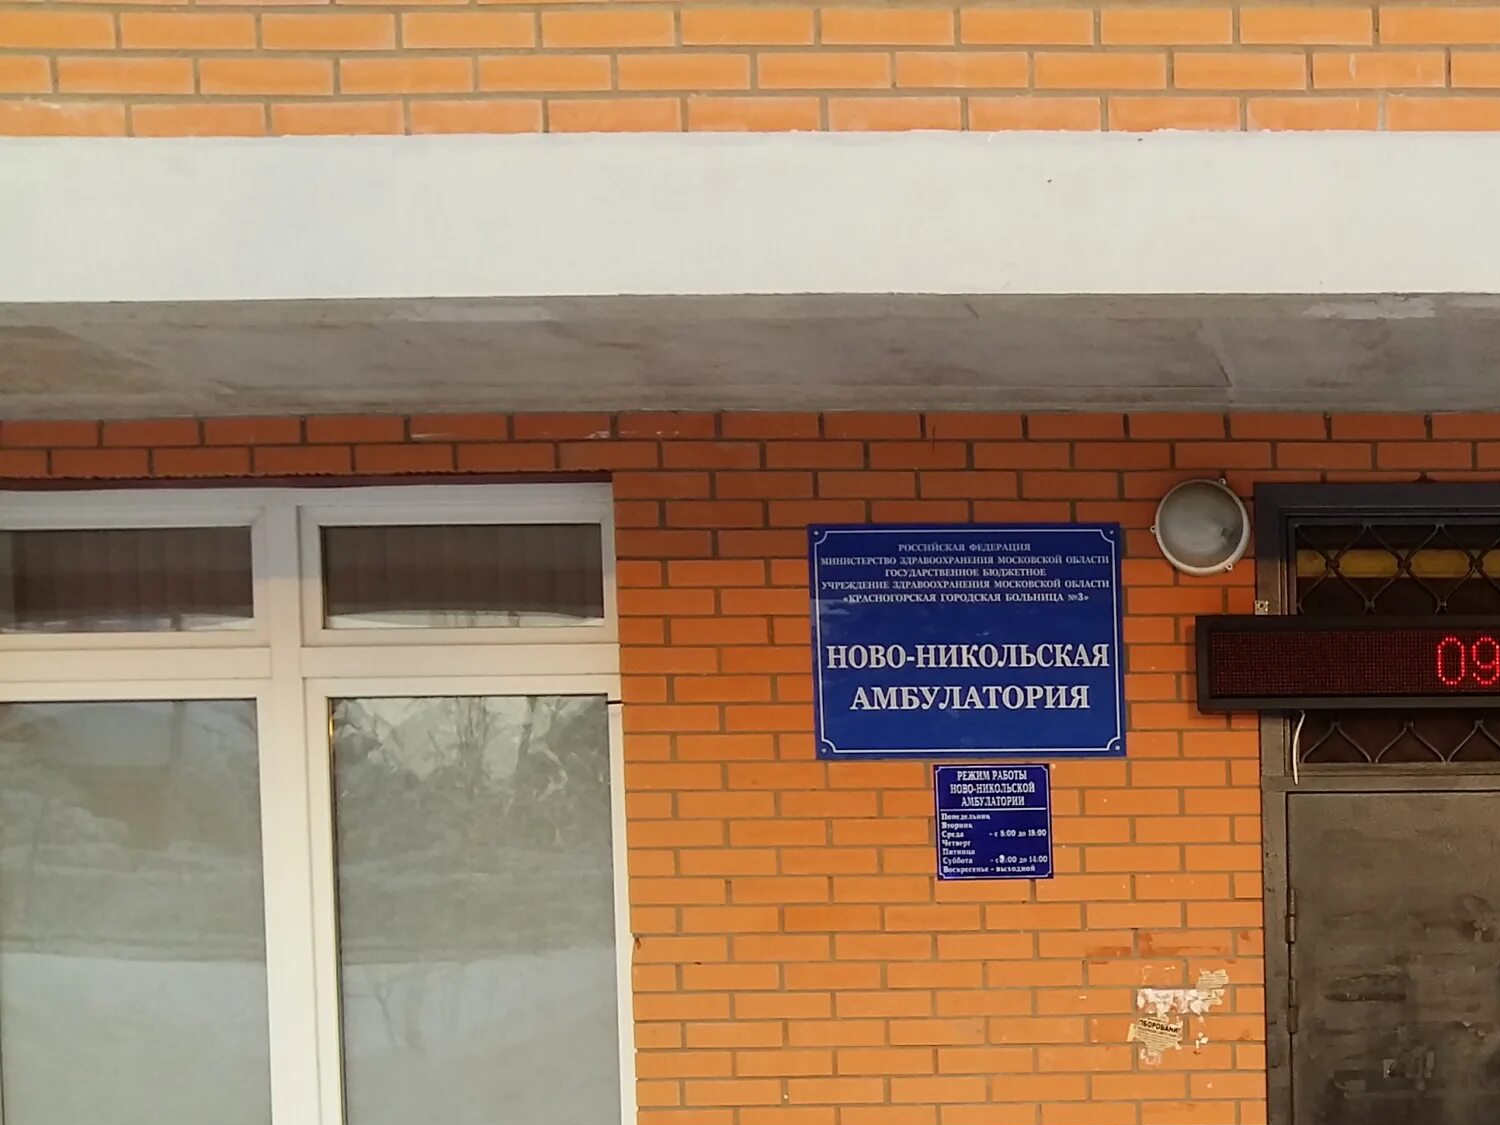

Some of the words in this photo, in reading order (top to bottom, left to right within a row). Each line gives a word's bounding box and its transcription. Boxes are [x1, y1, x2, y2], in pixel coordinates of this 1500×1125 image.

[898, 542, 965, 552] РОССИЙСКАЯ
[969, 543, 1031, 552] ФЕДЕРАЦИЯ
[821, 557, 896, 565] МИНИСТЕРСТВО
[900, 556, 994, 565] ЗДРАВООХРАНЕНИЯ
[998, 554, 1062, 564] МОСКОВСКОЙ
[1066, 555, 1109, 564] ОБЛАСТИ
[885, 568, 979, 578] ГОСУДАРСТВЕННОЕ
[983, 568, 1046, 577] БЮДЖЕТНОЕ
[821, 581, 889, 590] УЧРЕЖДЕНИЕ
[893, 580, 990, 590] ЗДРАВООХРАНЕНИЯ
[994, 578, 1061, 588] МОСКОВСКОЙ
[1065, 579, 1110, 589] ОБЛАСТИ
[941, 593, 1001, 603] ГОРОДСКАЯ
[1005, 593, 1064, 602] БОЛЬНИЦА
[826, 644, 1110, 669] НОВО-НИКОЛЬСКАЯ
[1436, 635, 1500, 686] 09
[849, 685, 1090, 711] АМБУЛАТОРИЯ
[957, 770, 990, 781] РЕЖИМ
[992, 770, 1027, 780] РАБОТЫ
[950, 781, 1035, 794] НОВО-НИКОЛЬСКОЙ
[961, 796, 1025, 807] АМБУЛАТОРИИ
[941, 830, 964, 839] Среда
[942, 857, 973, 866] Суббота
